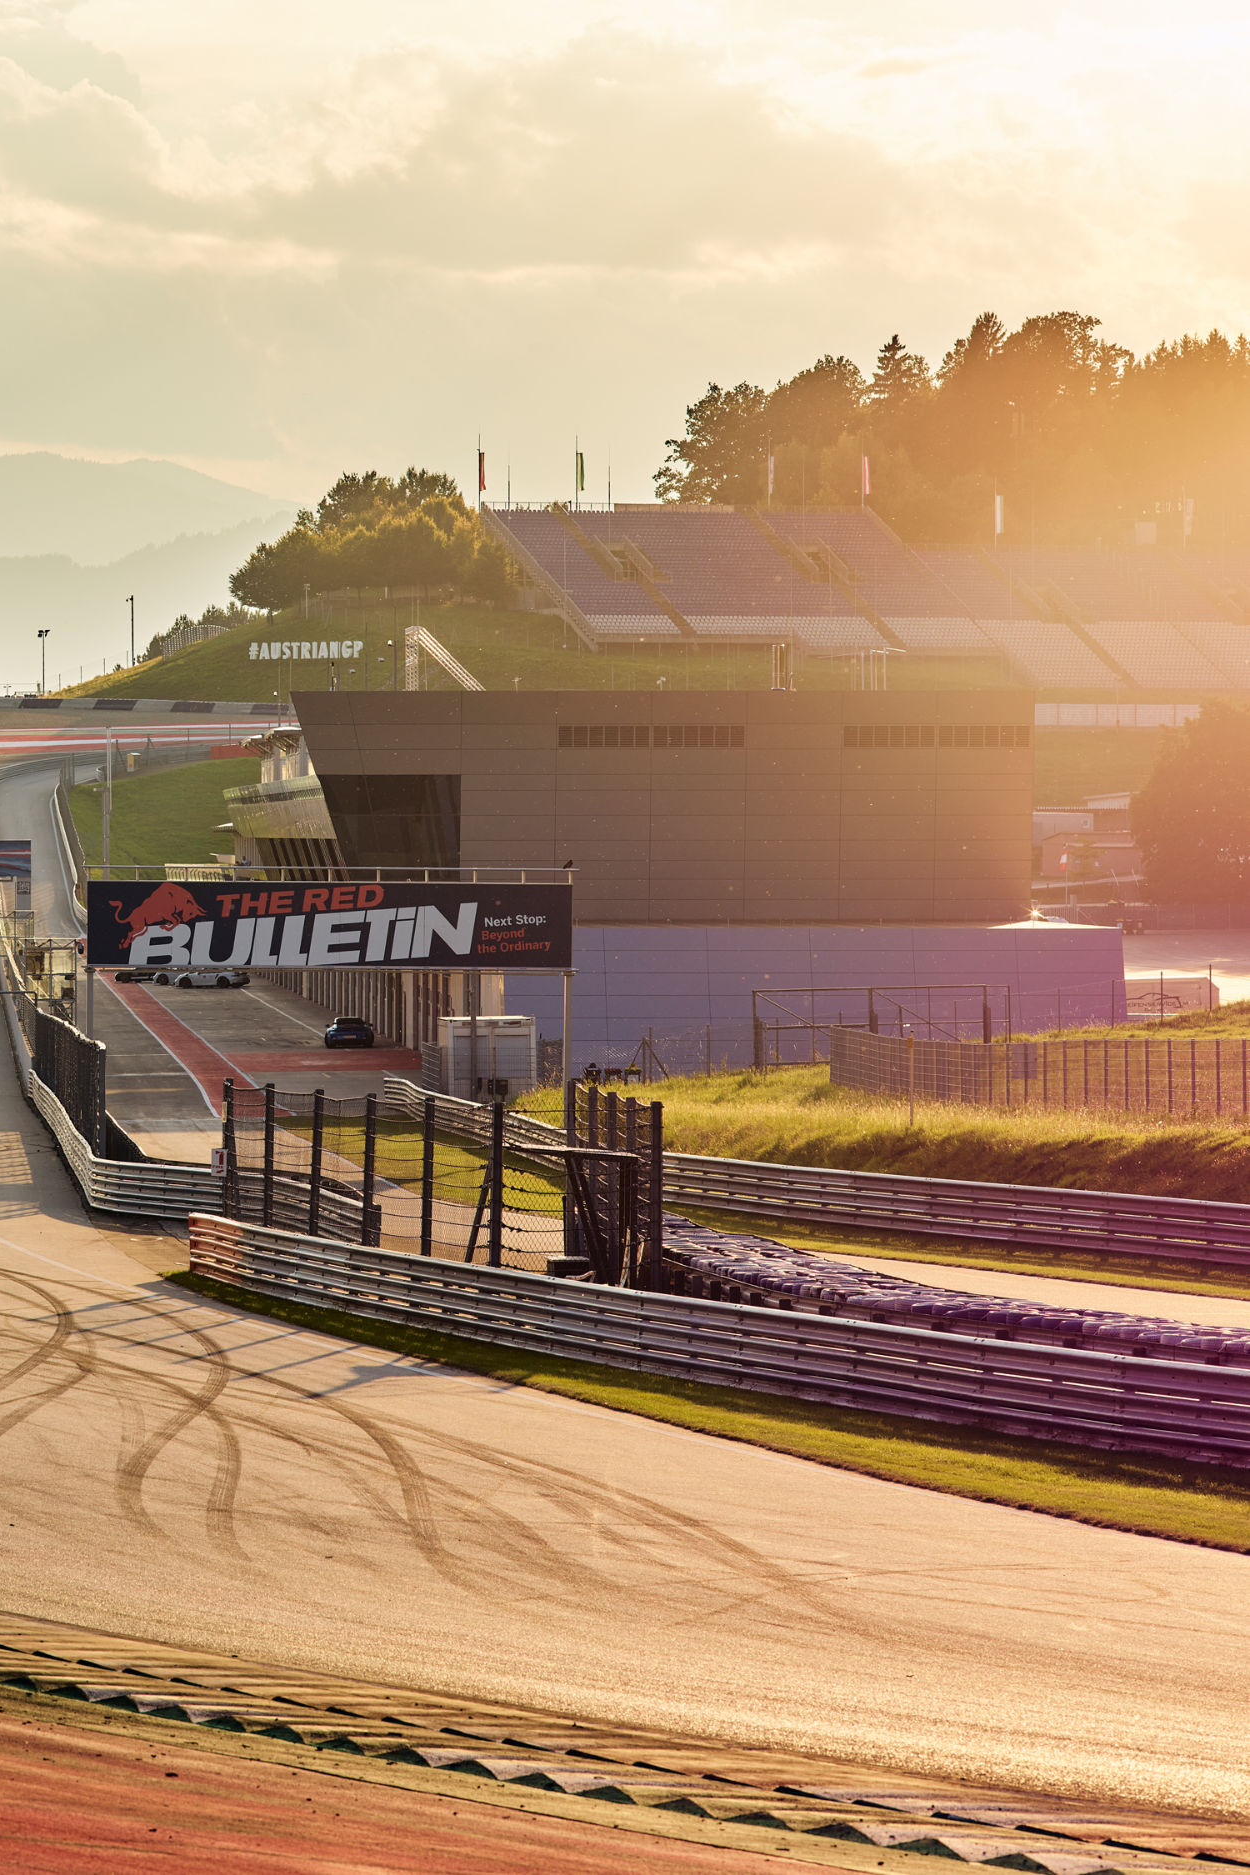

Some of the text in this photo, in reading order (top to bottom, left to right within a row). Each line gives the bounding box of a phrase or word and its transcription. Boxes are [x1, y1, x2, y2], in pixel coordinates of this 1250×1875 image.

[249, 641, 363, 660] #AUSTRIANGP
[217, 884, 384, 918] THE RED
[484, 914, 546, 927] Next Stop:
[481, 929, 525, 941] Beyond
[478, 941, 550, 954] the Ordinary
